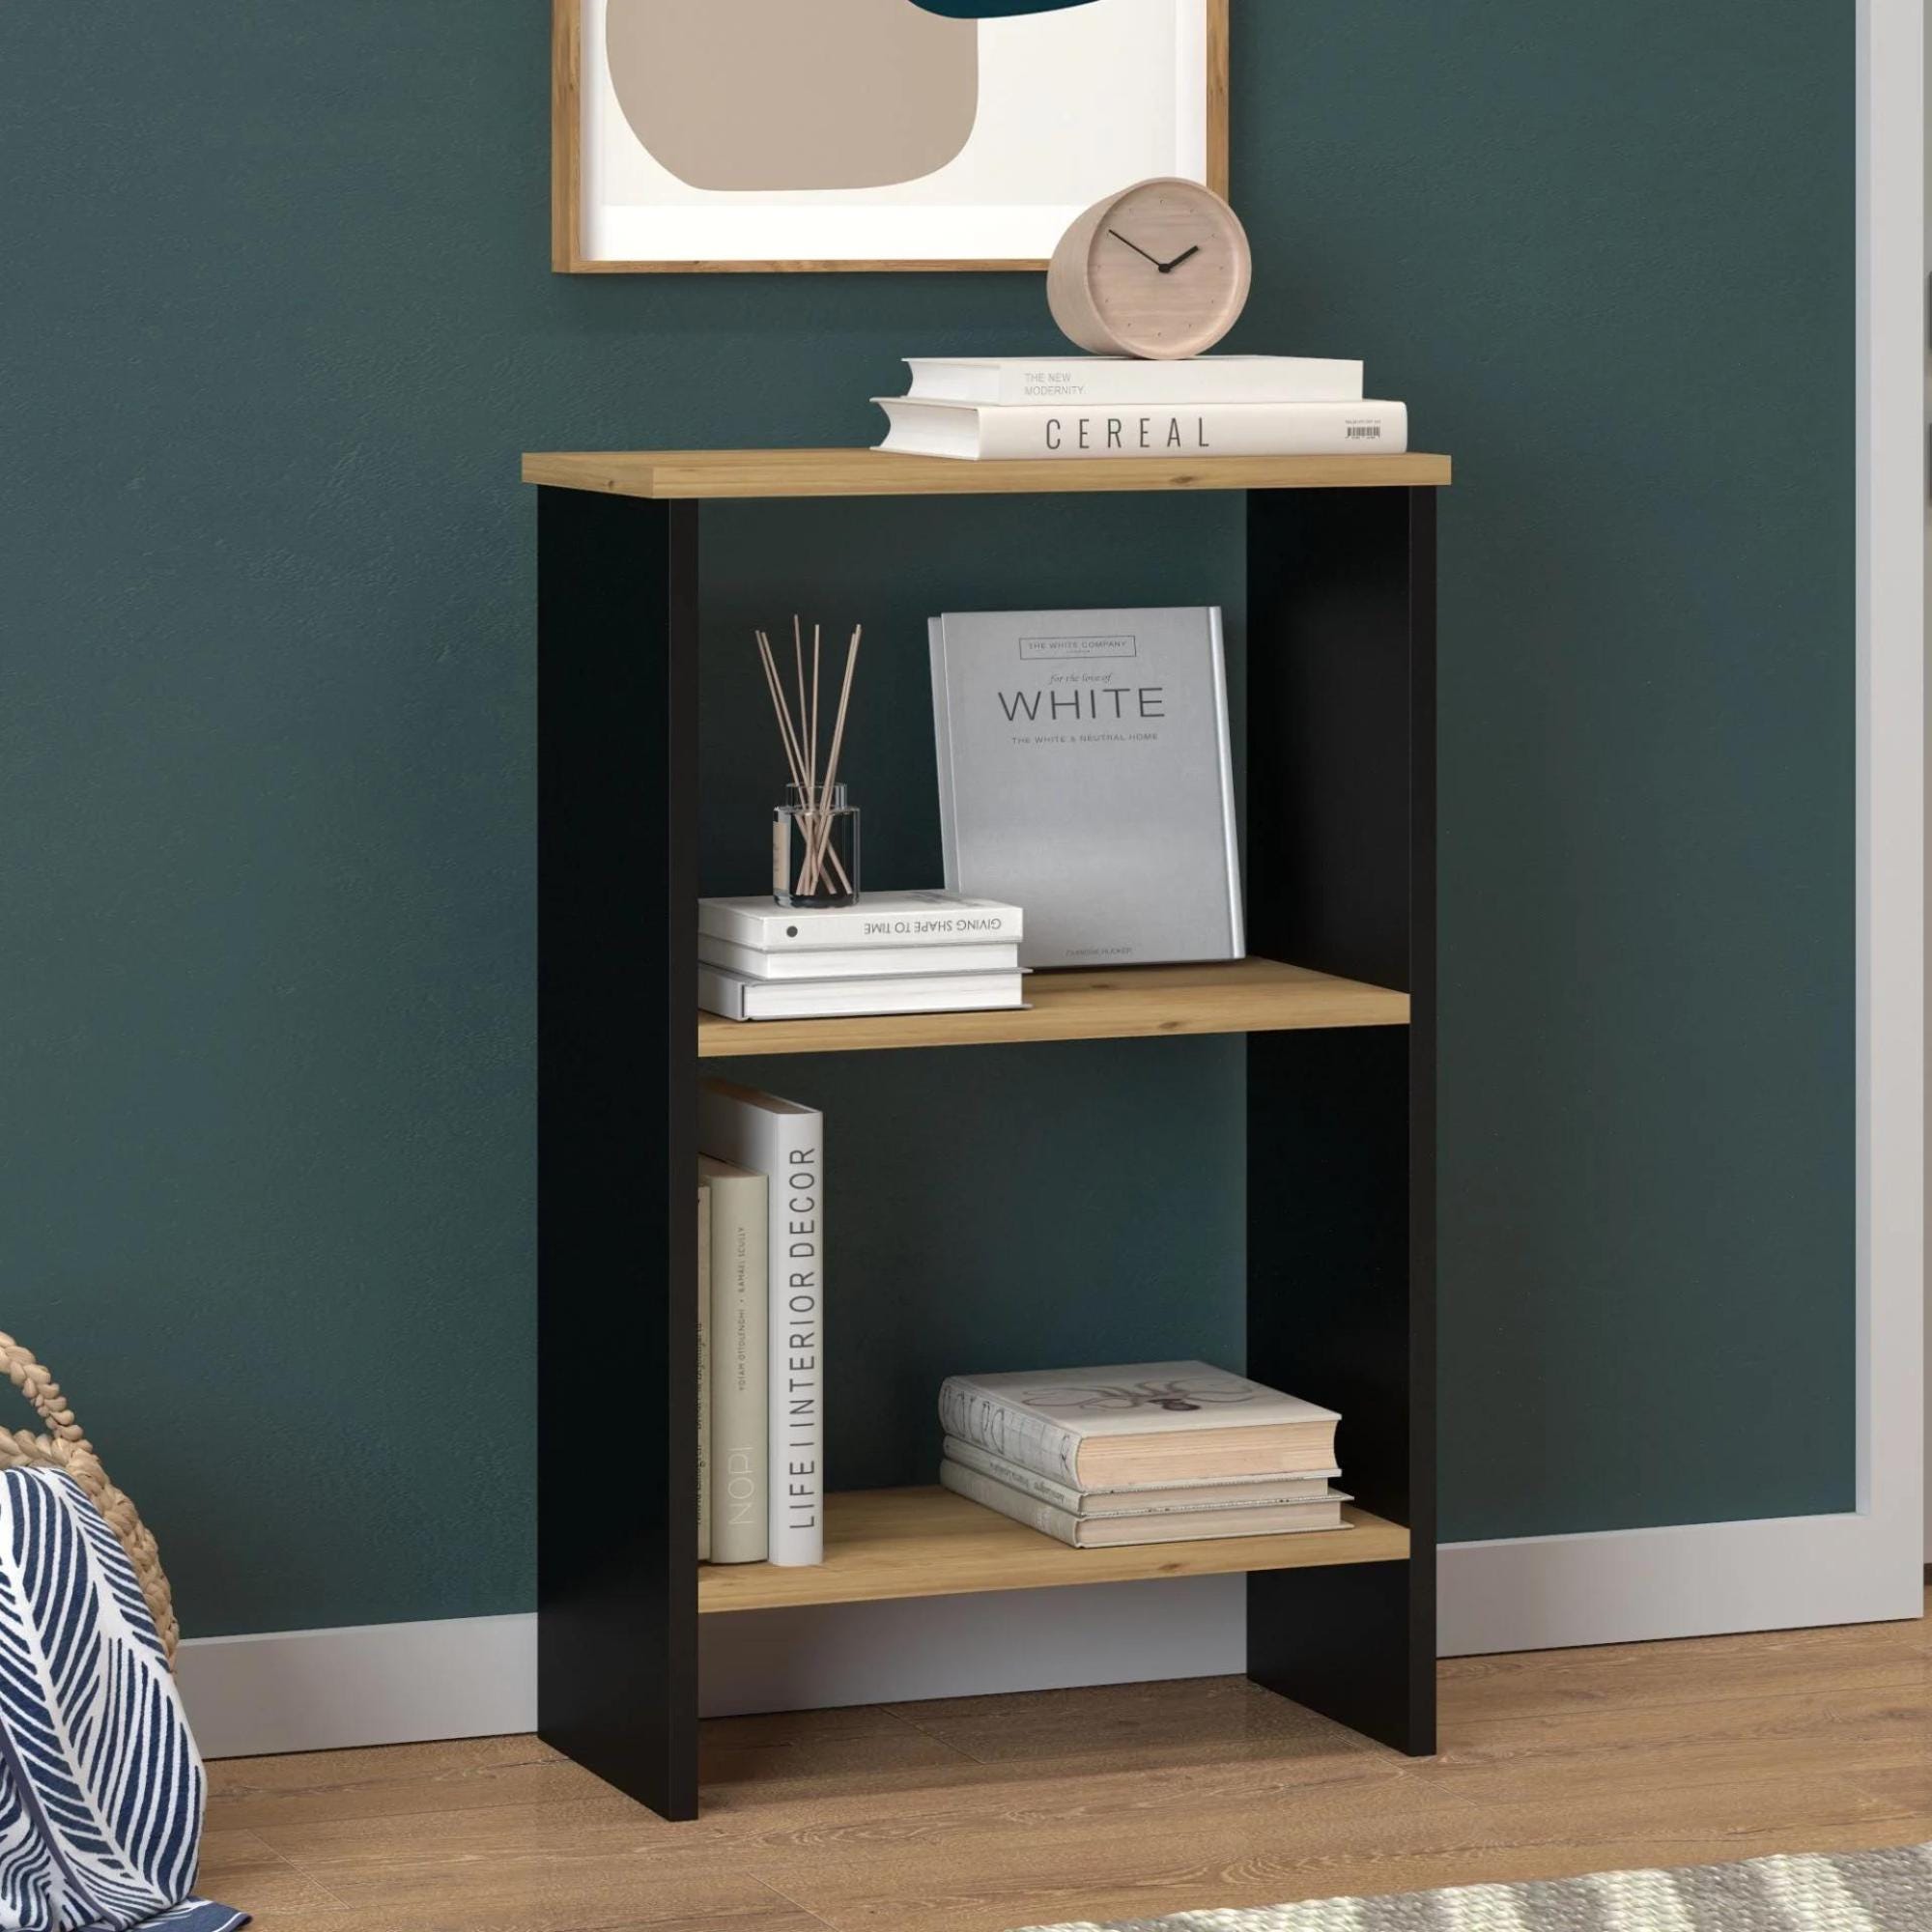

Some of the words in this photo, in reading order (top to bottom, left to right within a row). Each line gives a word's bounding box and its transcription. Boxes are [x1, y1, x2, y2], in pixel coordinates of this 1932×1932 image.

[1025, 373, 1044, 383] THE
[1048, 373, 1071, 383] NEW
[1046, 417, 1209, 449] CEREAL
[1082, 640, 1127, 649] COMPANY
[998, 688, 1165, 722] WHITE
[1035, 735, 1066, 744] WHITE
[1079, 734, 1125, 743] NEUTRAL
[864, 923, 892, 934] TIME
[895, 922, 912, 934] TO
[914, 920, 952, 933] SHAPE
[955, 918, 1003, 931] GIVING
[789, 1148, 815, 1258] DECOR
[789, 1270, 815, 1428] INTERIOR
[726, 1445, 755, 1525] NOPI
[789, 1461, 815, 1529] LIFE
